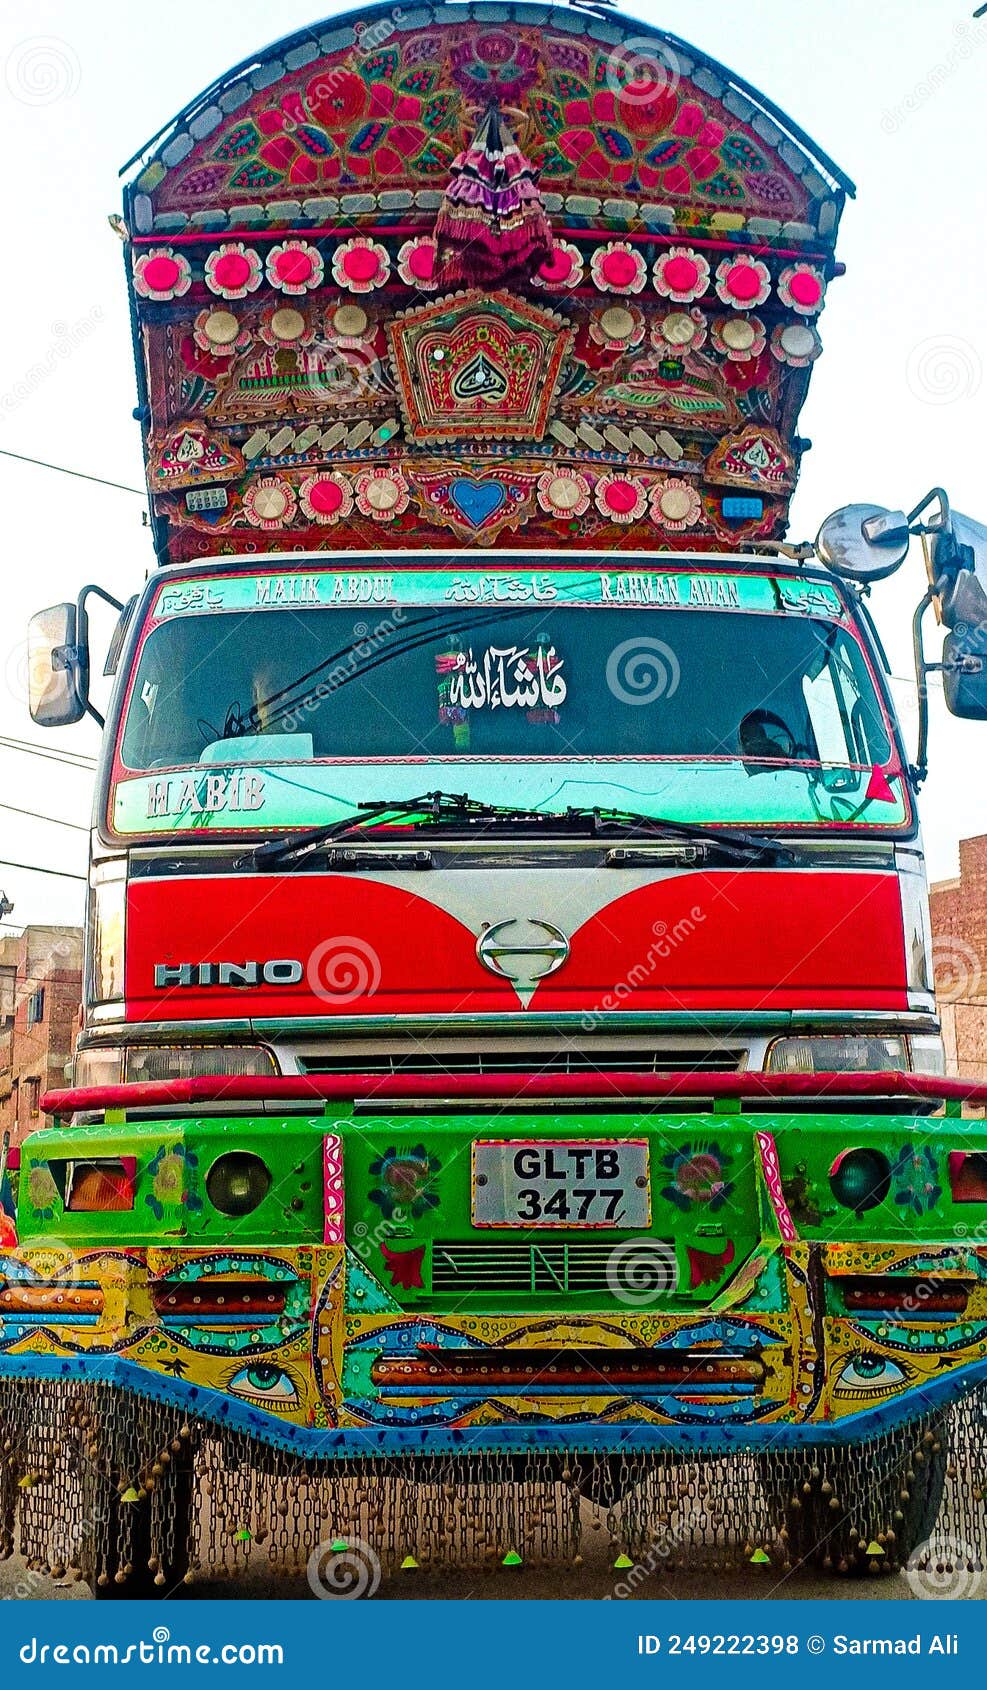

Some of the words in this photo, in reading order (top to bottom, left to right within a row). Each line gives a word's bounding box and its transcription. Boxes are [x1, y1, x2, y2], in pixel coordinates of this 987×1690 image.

[255, 577, 320, 605] MALIK
[330, 576, 398, 604] ABDUL
[601, 575, 680, 606] RAHMAN
[688, 578, 740, 608] AWAN
[147, 774, 266, 818] HABIB
[154, 959, 304, 988] HINO
[513, 1148, 620, 1180] GLTB
[517, 1188, 624, 1221] 3477
